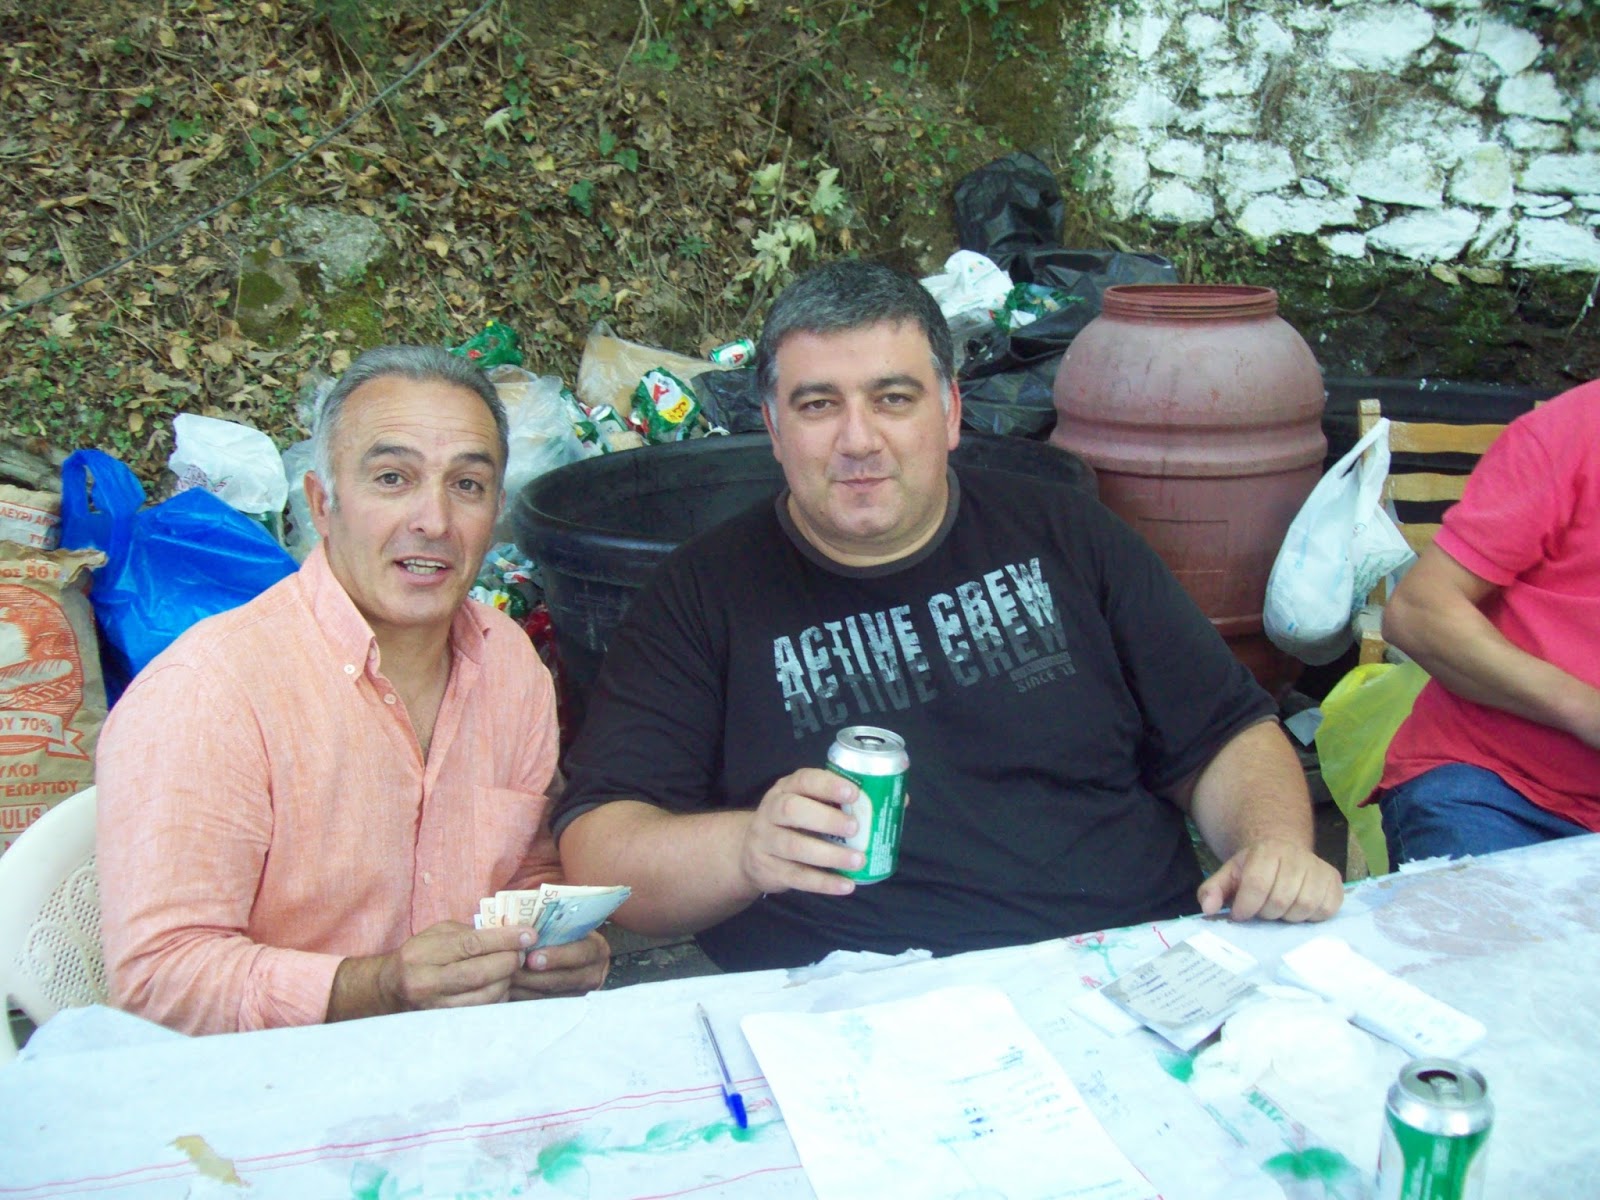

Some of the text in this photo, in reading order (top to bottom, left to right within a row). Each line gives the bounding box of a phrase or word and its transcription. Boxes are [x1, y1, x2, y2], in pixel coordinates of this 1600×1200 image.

[773, 557, 1055, 712] ACTIVE CREW
[20, 717, 52, 733] 70%
[519, 899, 536, 916] 50
